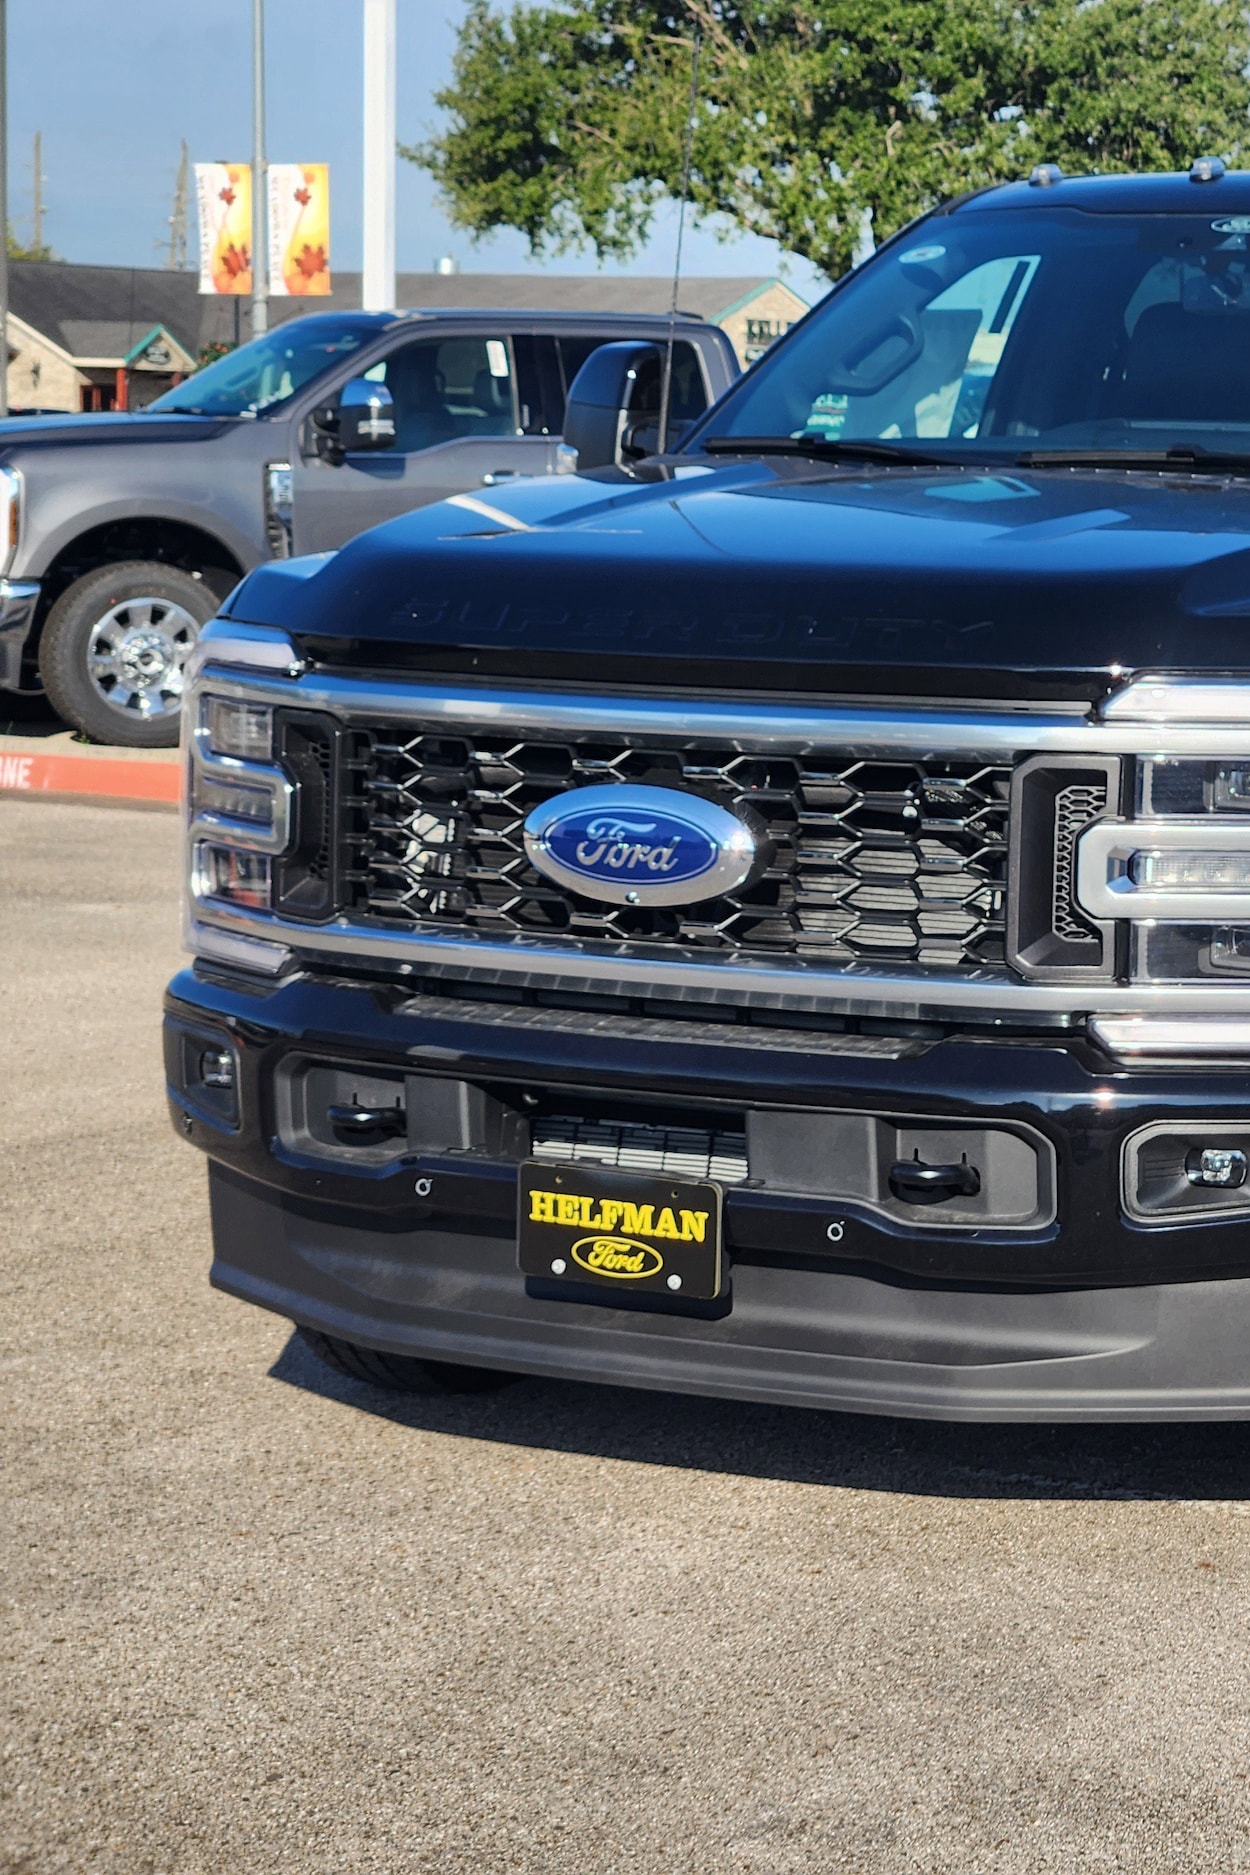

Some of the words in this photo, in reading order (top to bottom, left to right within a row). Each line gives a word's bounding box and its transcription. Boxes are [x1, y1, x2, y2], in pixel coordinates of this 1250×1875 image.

[0, 756, 34, 789] NE
[575, 817, 683, 872] Ford
[528, 1189, 710, 1243] HELFMAN
[587, 1239, 646, 1273] Ford
